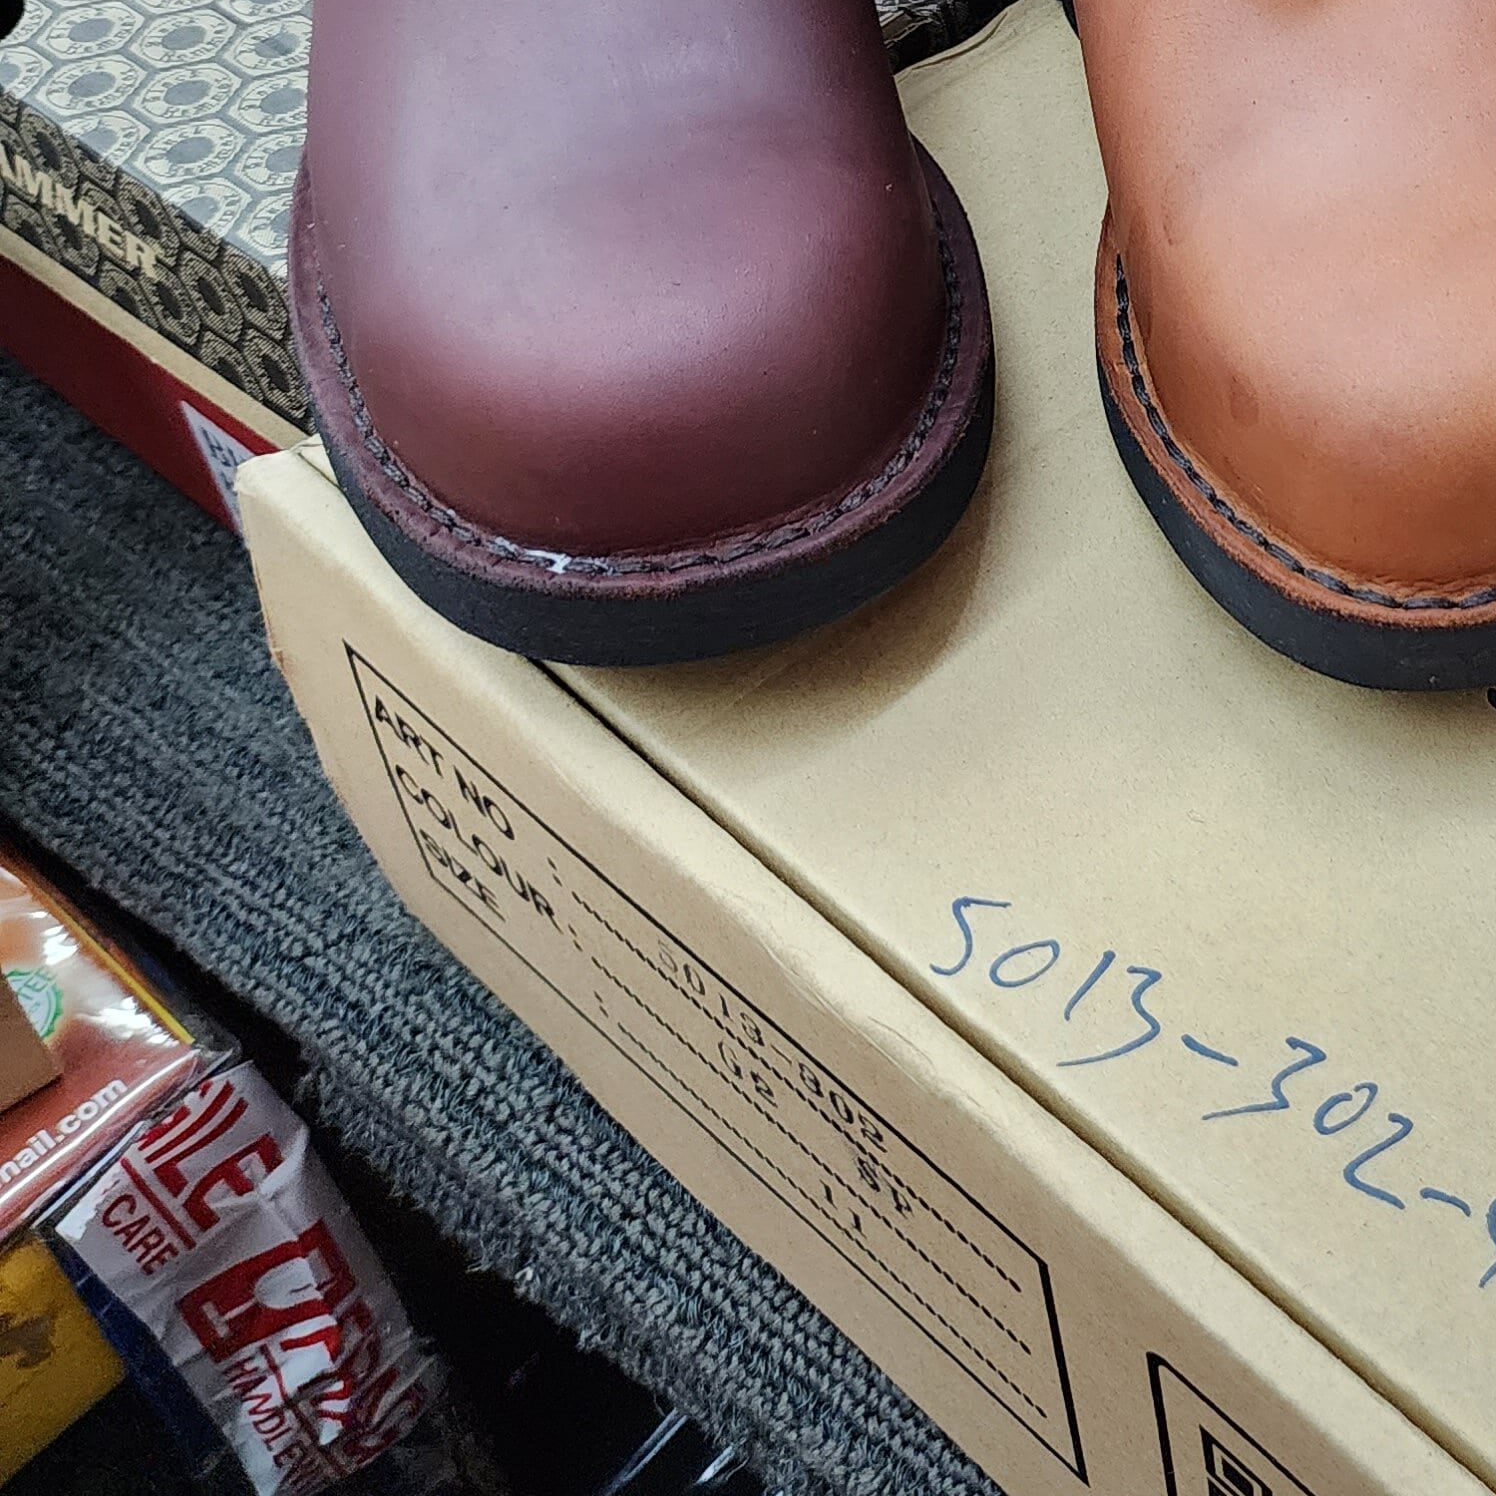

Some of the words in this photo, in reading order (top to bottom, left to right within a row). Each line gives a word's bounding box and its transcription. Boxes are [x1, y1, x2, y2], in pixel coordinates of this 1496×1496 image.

[374, 694, 445, 780] ART
[452, 764, 516, 841] NO
[395, 764, 564, 936] COLOUR
[419, 828, 508, 924] SIZE
[101, 1193, 180, 1277] CARE
